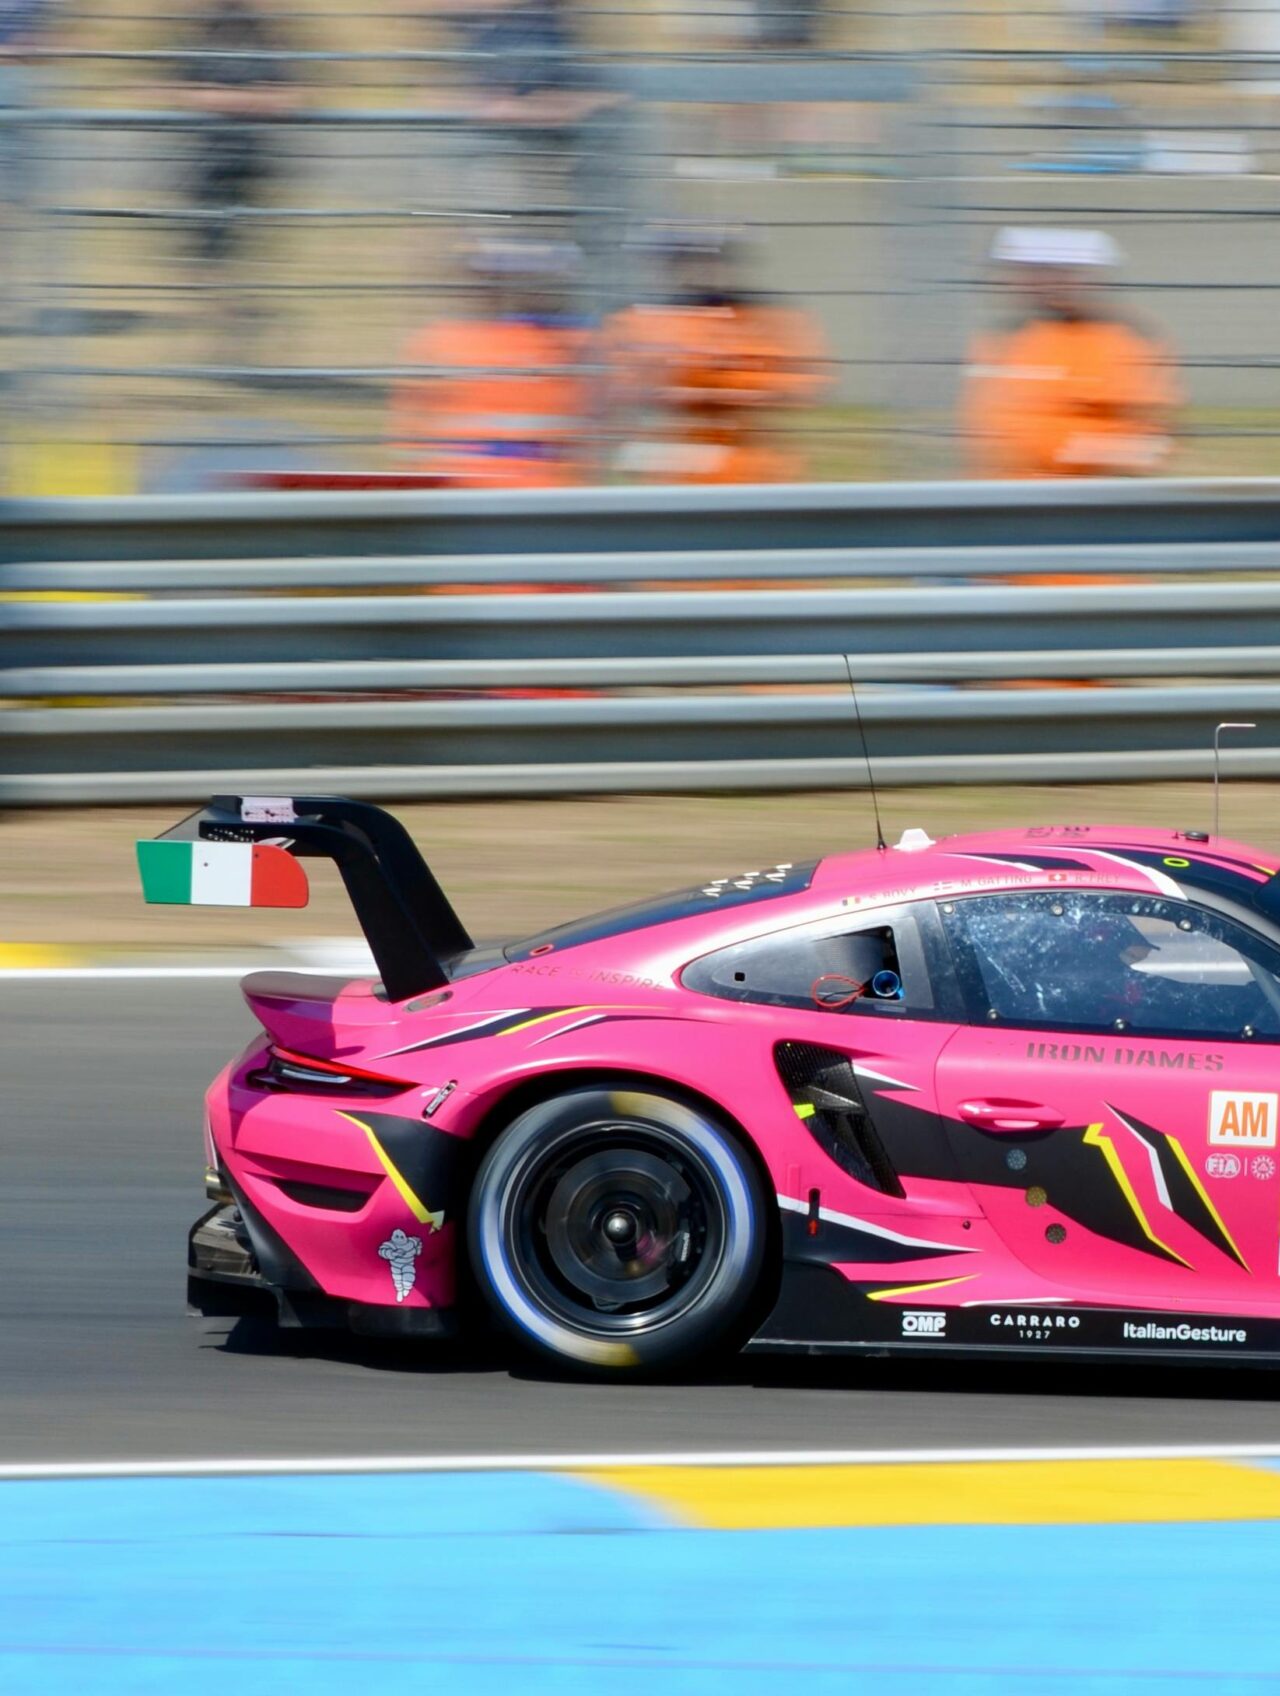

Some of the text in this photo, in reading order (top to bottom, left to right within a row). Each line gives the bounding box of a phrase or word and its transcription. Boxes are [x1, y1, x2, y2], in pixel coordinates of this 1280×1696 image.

[588, 970, 665, 992] INSPIRE
[1026, 1042, 1224, 1072] IRON DAMES
[1219, 1101, 1268, 1137] AM
[1207, 1158, 1238, 1174] FIA
[902, 1315, 946, 1332] OMP
[990, 1314, 1080, 1328] CARRARO
[1019, 1330, 1050, 1339] 1927
[1123, 1322, 1247, 1343] ItalianGesture
